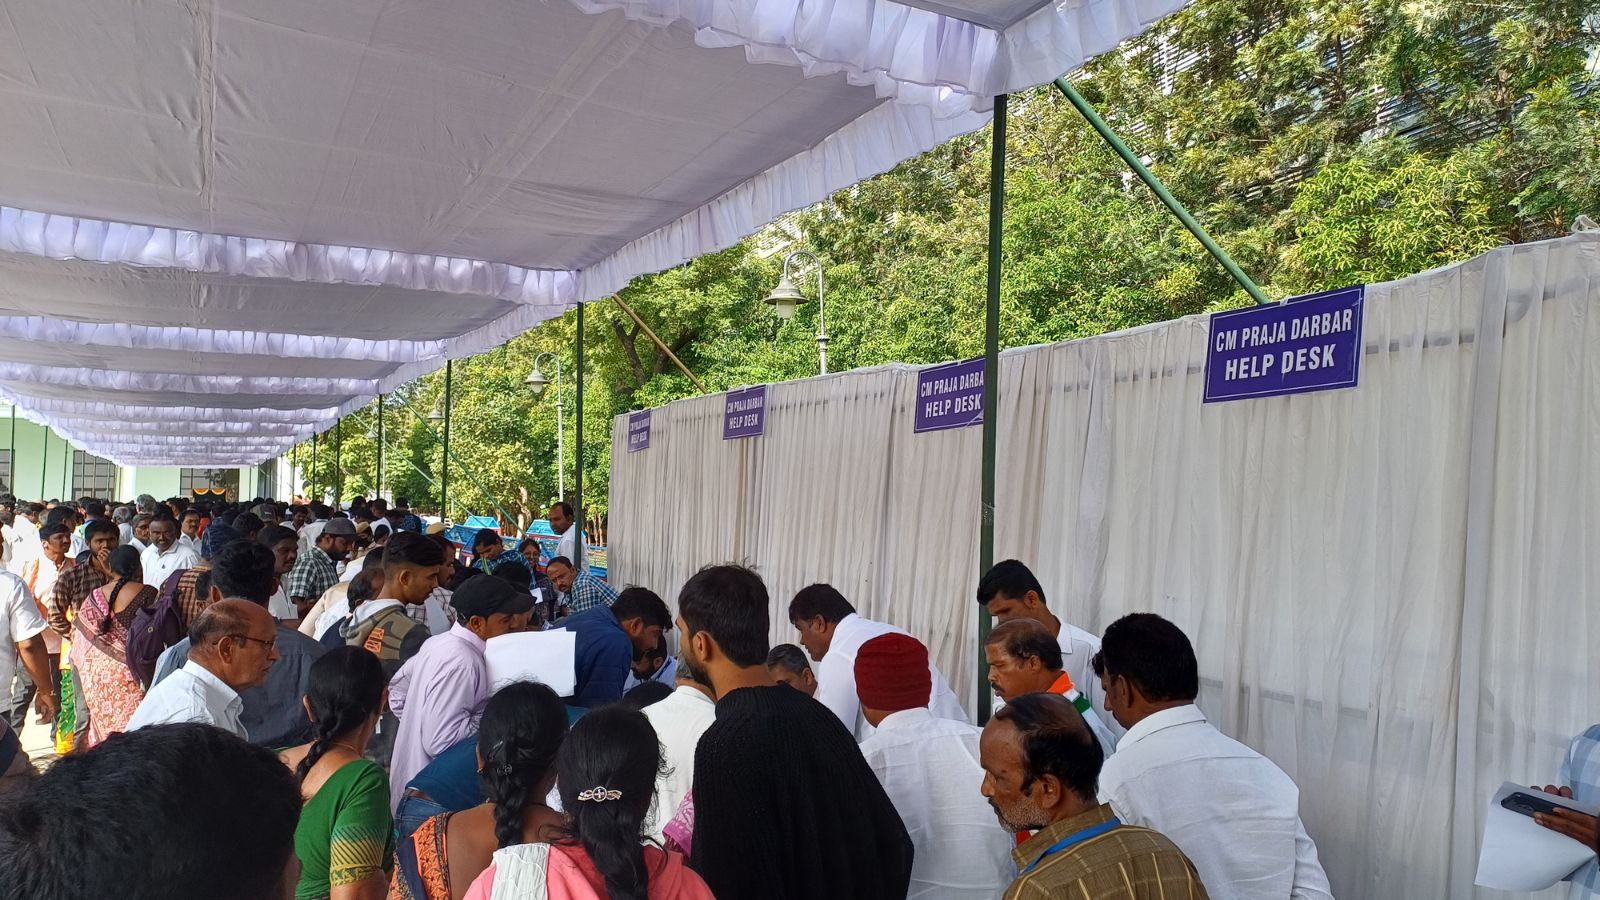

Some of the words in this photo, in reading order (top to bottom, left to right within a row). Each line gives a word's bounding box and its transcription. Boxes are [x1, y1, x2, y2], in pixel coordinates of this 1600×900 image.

[1216, 330, 1237, 353] CM
[1241, 321, 1286, 348] PRAJA
[1291, 308, 1353, 340] DARBAR
[1225, 354, 1274, 381] HELP
[1281, 343, 1336, 374] DESK
[921, 381, 932, 398] CM
[934, 376, 958, 395] PRAJA
[959, 370, 984, 391] DARBA
[925, 399, 951, 418] HELP
[954, 393, 982, 414] DESK
[729, 416, 743, 430] HELP
[744, 413, 758, 427] DESK
